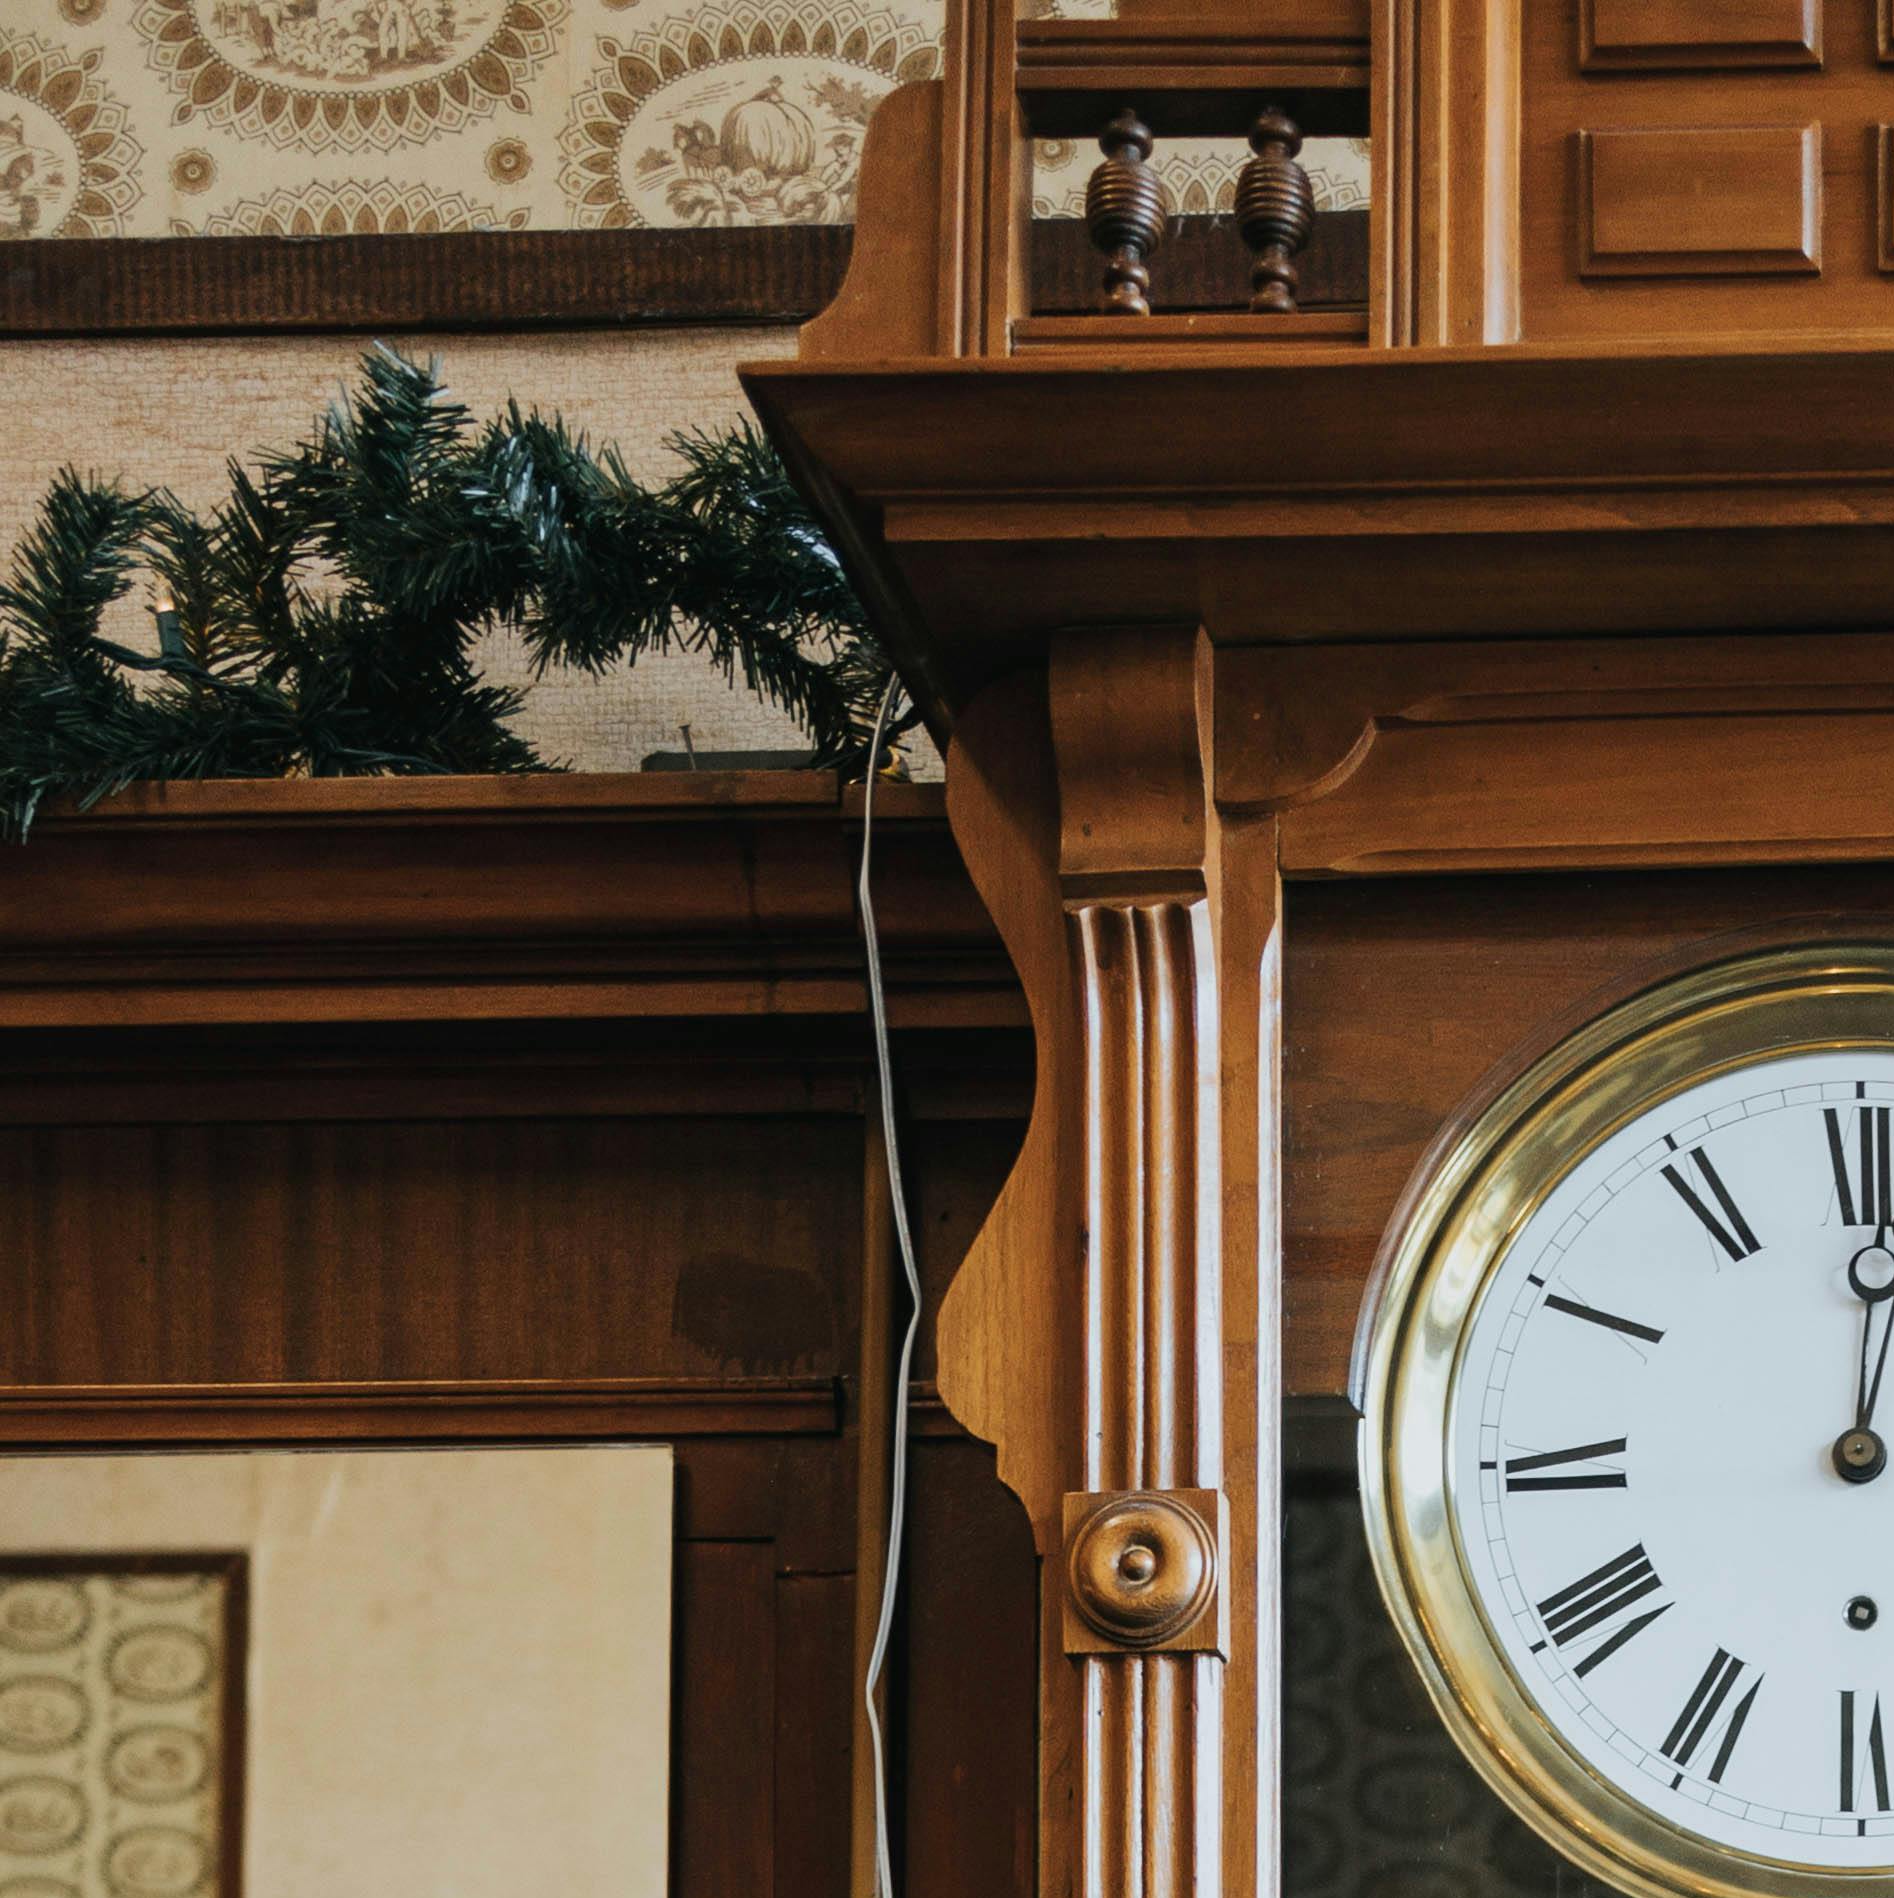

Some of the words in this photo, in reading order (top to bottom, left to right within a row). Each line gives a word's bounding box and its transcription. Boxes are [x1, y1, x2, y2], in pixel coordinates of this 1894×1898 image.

[1659, 1144, 1768, 1273] XI
[1816, 1106, 1894, 1228] XII
[1543, 1273, 1668, 1365] X
[1504, 1433, 1629, 1495] IX
[1535, 1540, 1677, 1680] VIII
[1659, 1645, 1766, 1785] VII
[1838, 1689, 1892, 1813] VI
